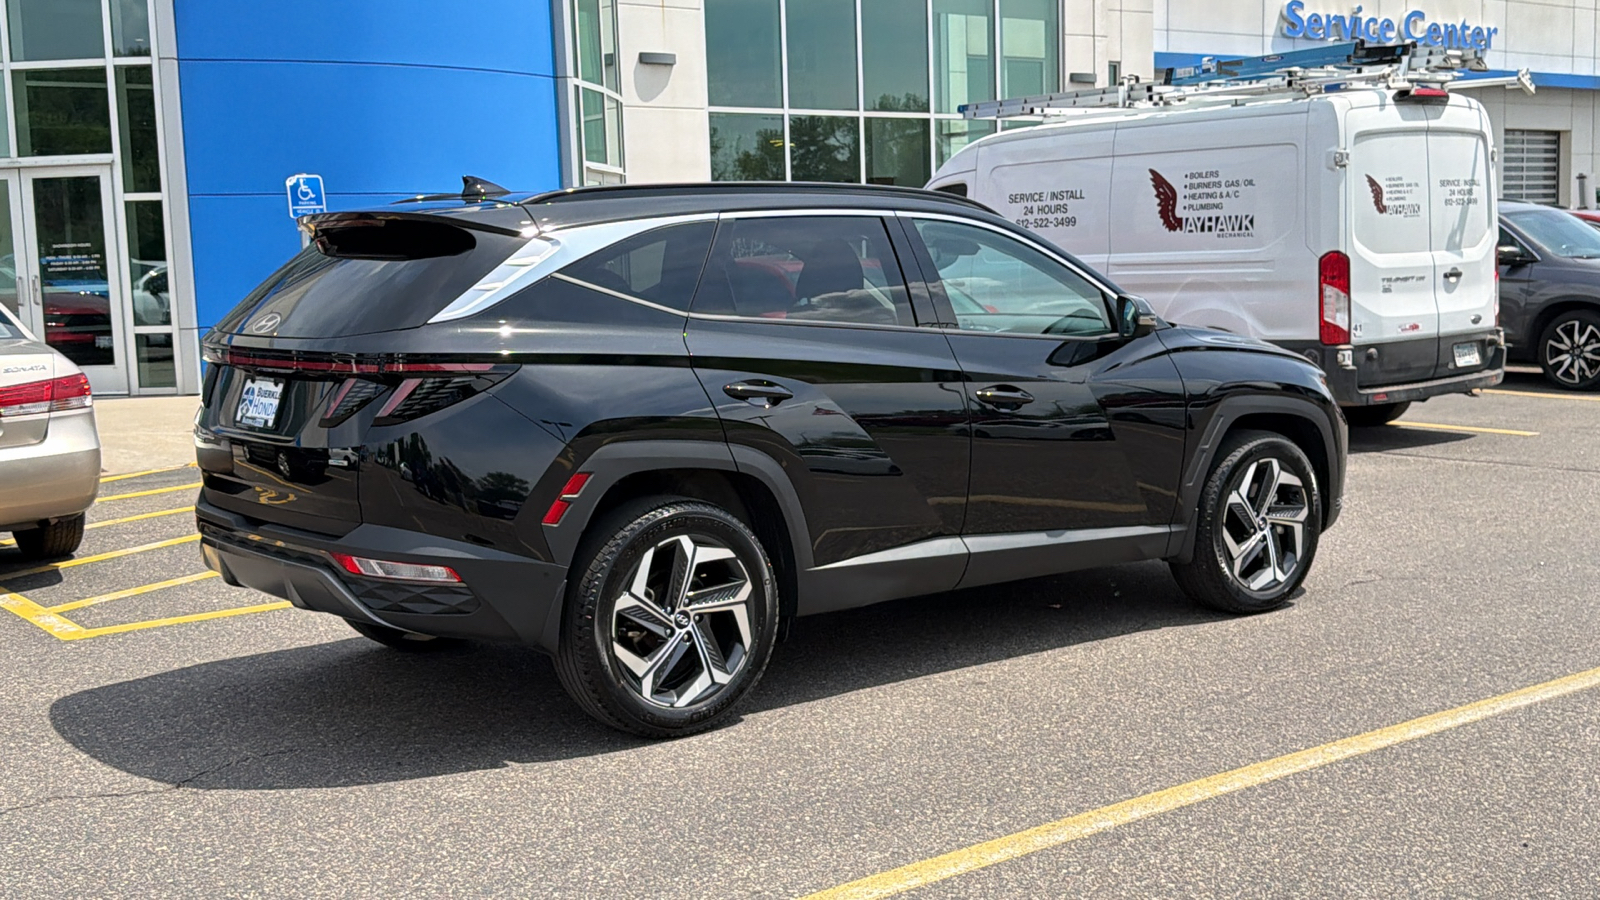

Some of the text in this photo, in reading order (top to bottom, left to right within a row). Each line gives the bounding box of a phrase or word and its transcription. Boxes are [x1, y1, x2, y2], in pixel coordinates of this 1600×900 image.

[1282, 0, 1498, 49] Service Center
[1189, 170, 1219, 180] BOILERS
[1188, 180, 1222, 190] BURNERS
[1188, 191, 1217, 201] HEATING
[1218, 192, 1223, 200] &
[1023, 203, 1068, 216] 24 HOURS
[1187, 202, 1224, 211] PLUMBING
[1352, 323, 1363, 333] 41
[3, 364, 47, 374] SONATA
[251, 398, 279, 417] HONDA
